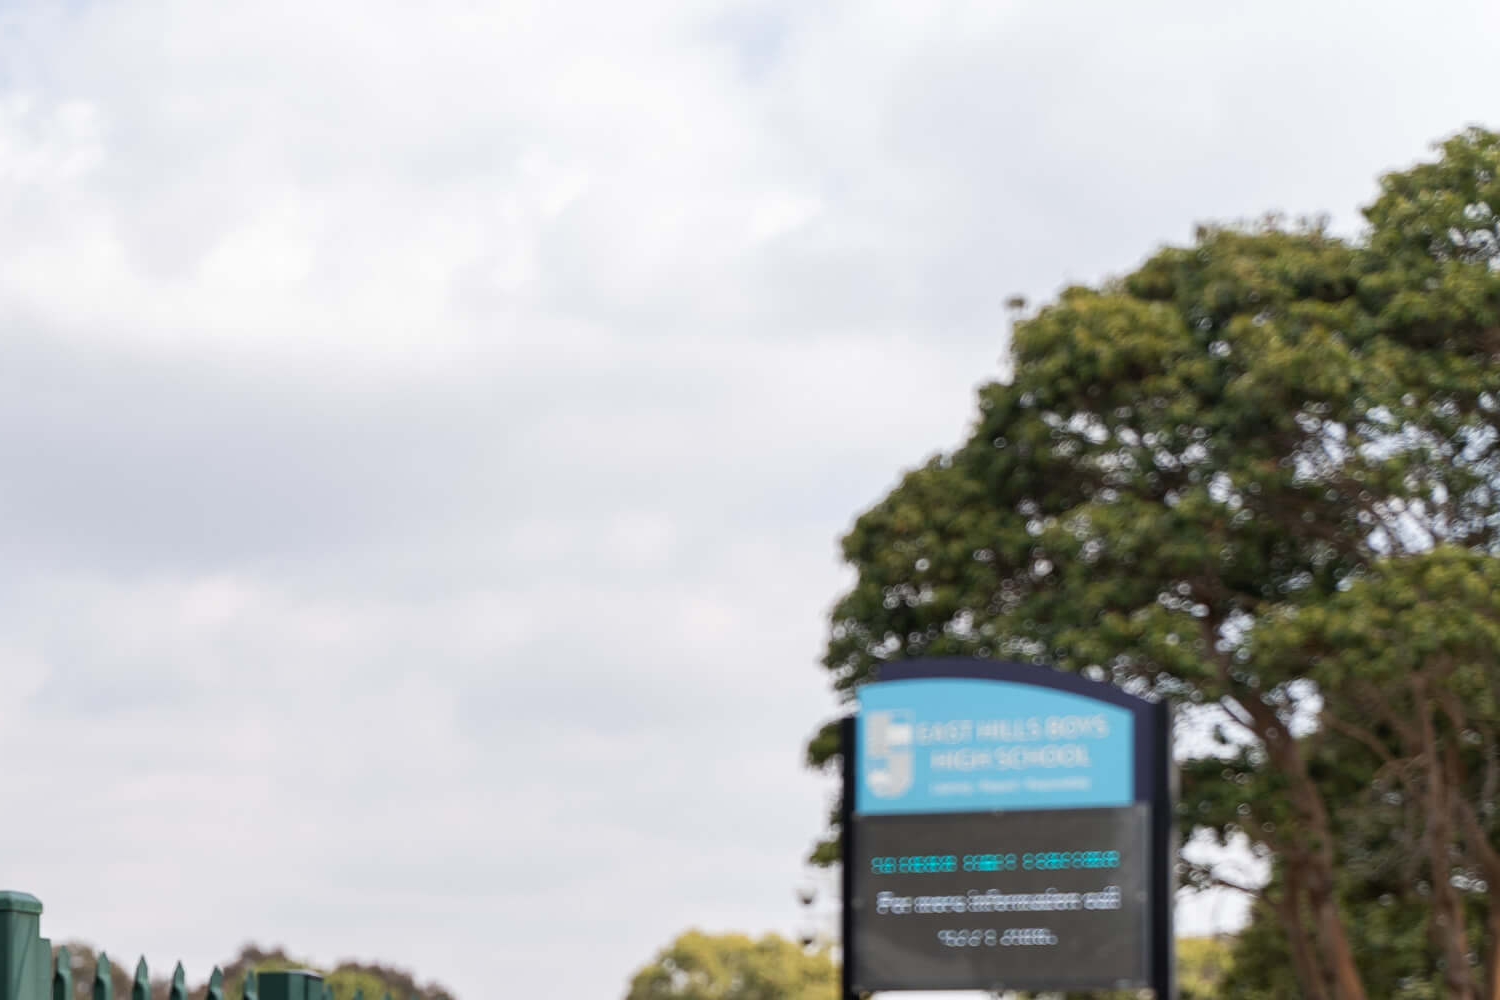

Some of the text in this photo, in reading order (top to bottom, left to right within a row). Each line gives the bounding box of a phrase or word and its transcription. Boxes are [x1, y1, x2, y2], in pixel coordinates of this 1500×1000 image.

[917, 721, 972, 744] EAST
[978, 718, 1041, 741] HILLS
[932, 745, 1092, 771] HIGH SCHOOL
